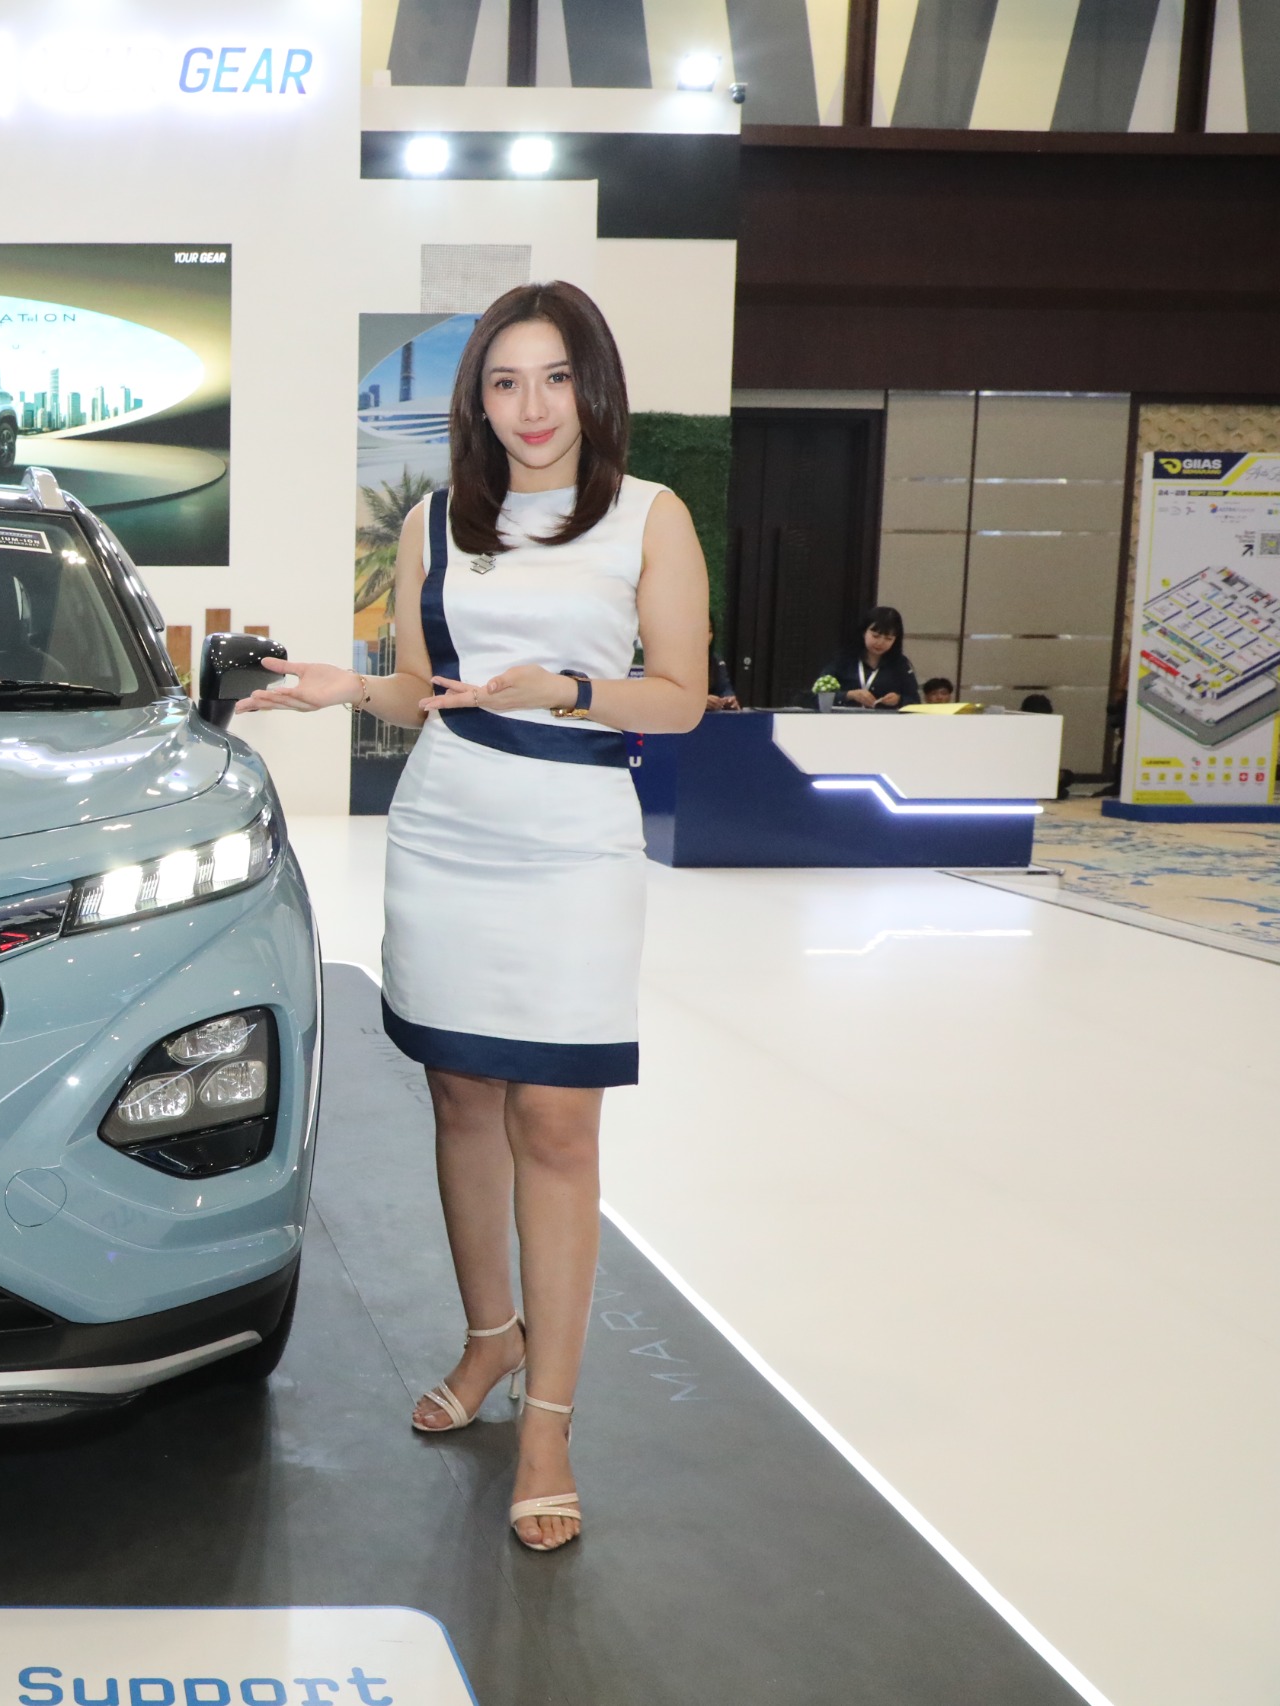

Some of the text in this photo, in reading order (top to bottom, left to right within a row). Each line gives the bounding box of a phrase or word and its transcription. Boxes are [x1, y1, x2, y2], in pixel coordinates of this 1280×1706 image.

[178, 46, 314, 95] GEAR
[174, 251, 227, 263] YOUR GEAR
[1182, 459, 1222, 469] GIIAS
[18, 1666, 394, 1706] Support
